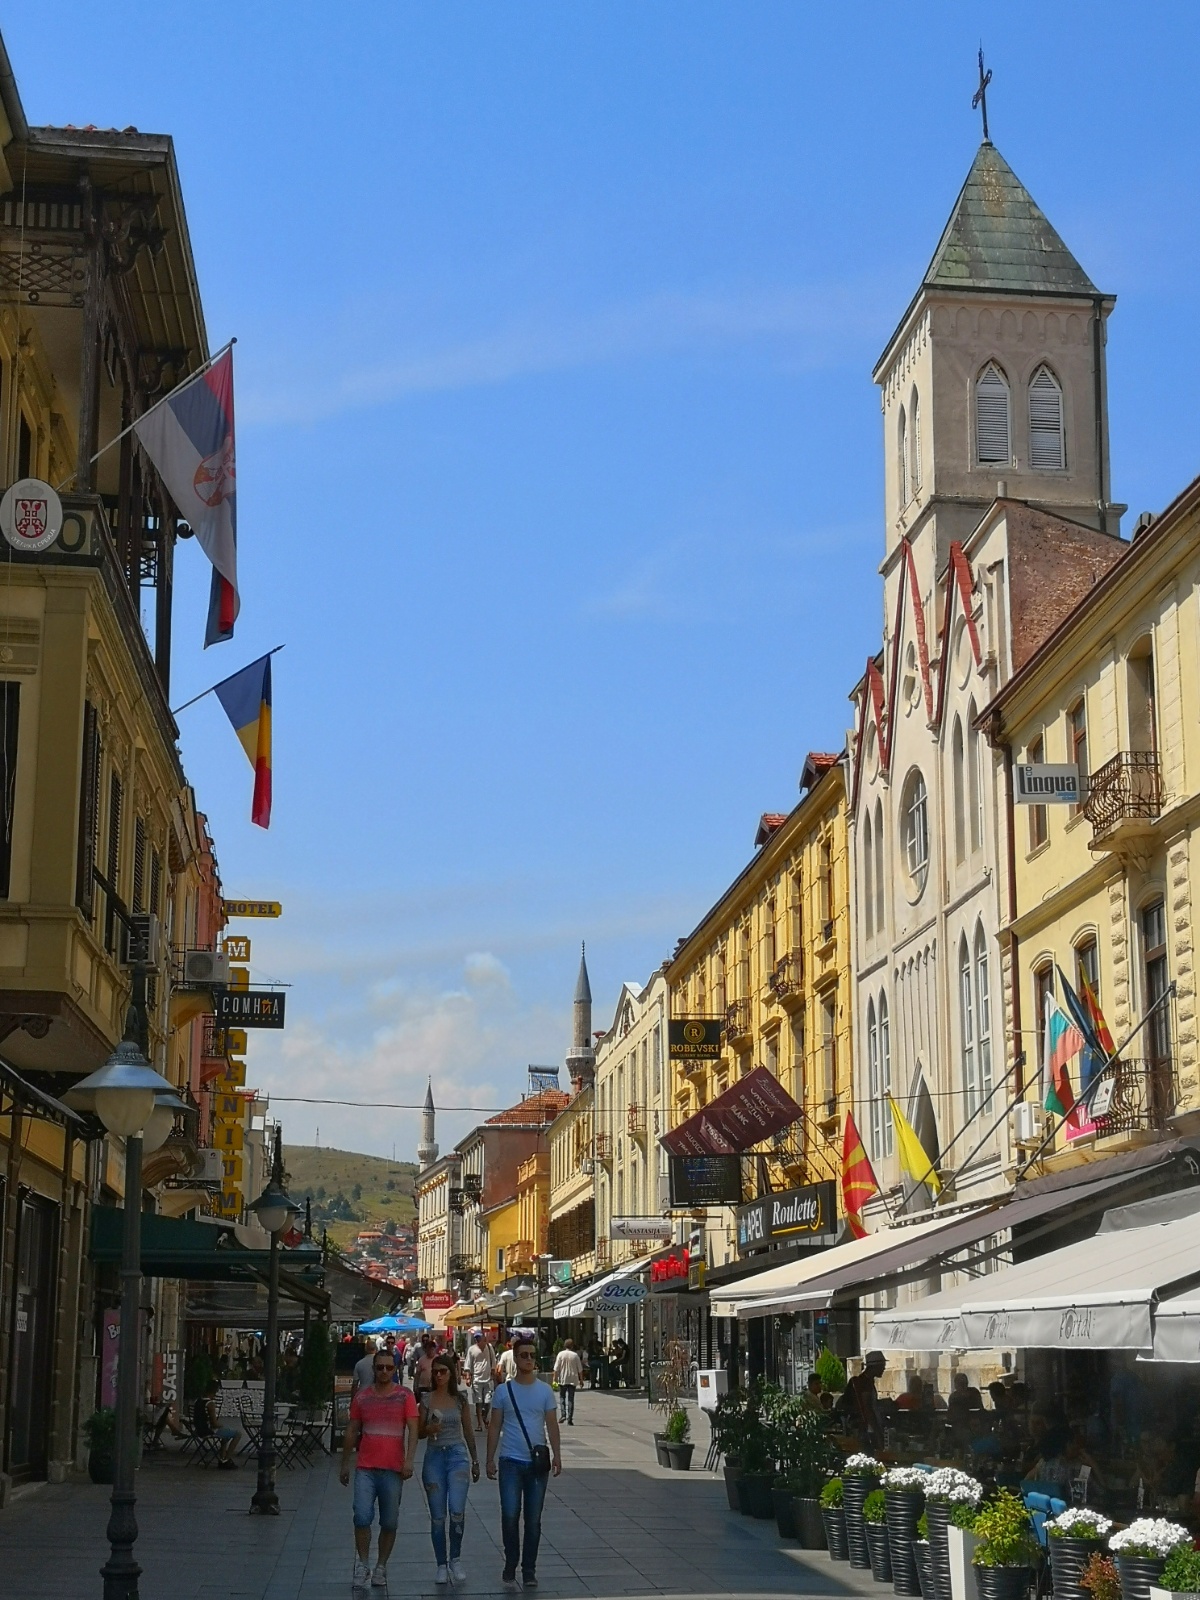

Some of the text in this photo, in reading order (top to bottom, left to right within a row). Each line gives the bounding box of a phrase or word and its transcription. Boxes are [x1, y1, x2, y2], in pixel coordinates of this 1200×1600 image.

[1018, 766, 1077, 795] Lingua
[225, 902, 276, 915] HOTEL
[691, 1028, 698, 1037] R
[670, 1044, 719, 1053] ROBEVSKI
[739, 1094, 766, 1126] BREITLING
[750, 1087, 775, 1118] OMEGA
[705, 1122, 727, 1148] TISSOT
[747, 1206, 764, 1242] APEX
[772, 1196, 817, 1226] Roulette
[425, 1294, 449, 1302] adam's
[603, 1284, 645, 1298] Peko
[595, 1302, 624, 1311] Peko
[162, 1353, 177, 1401] SALE
